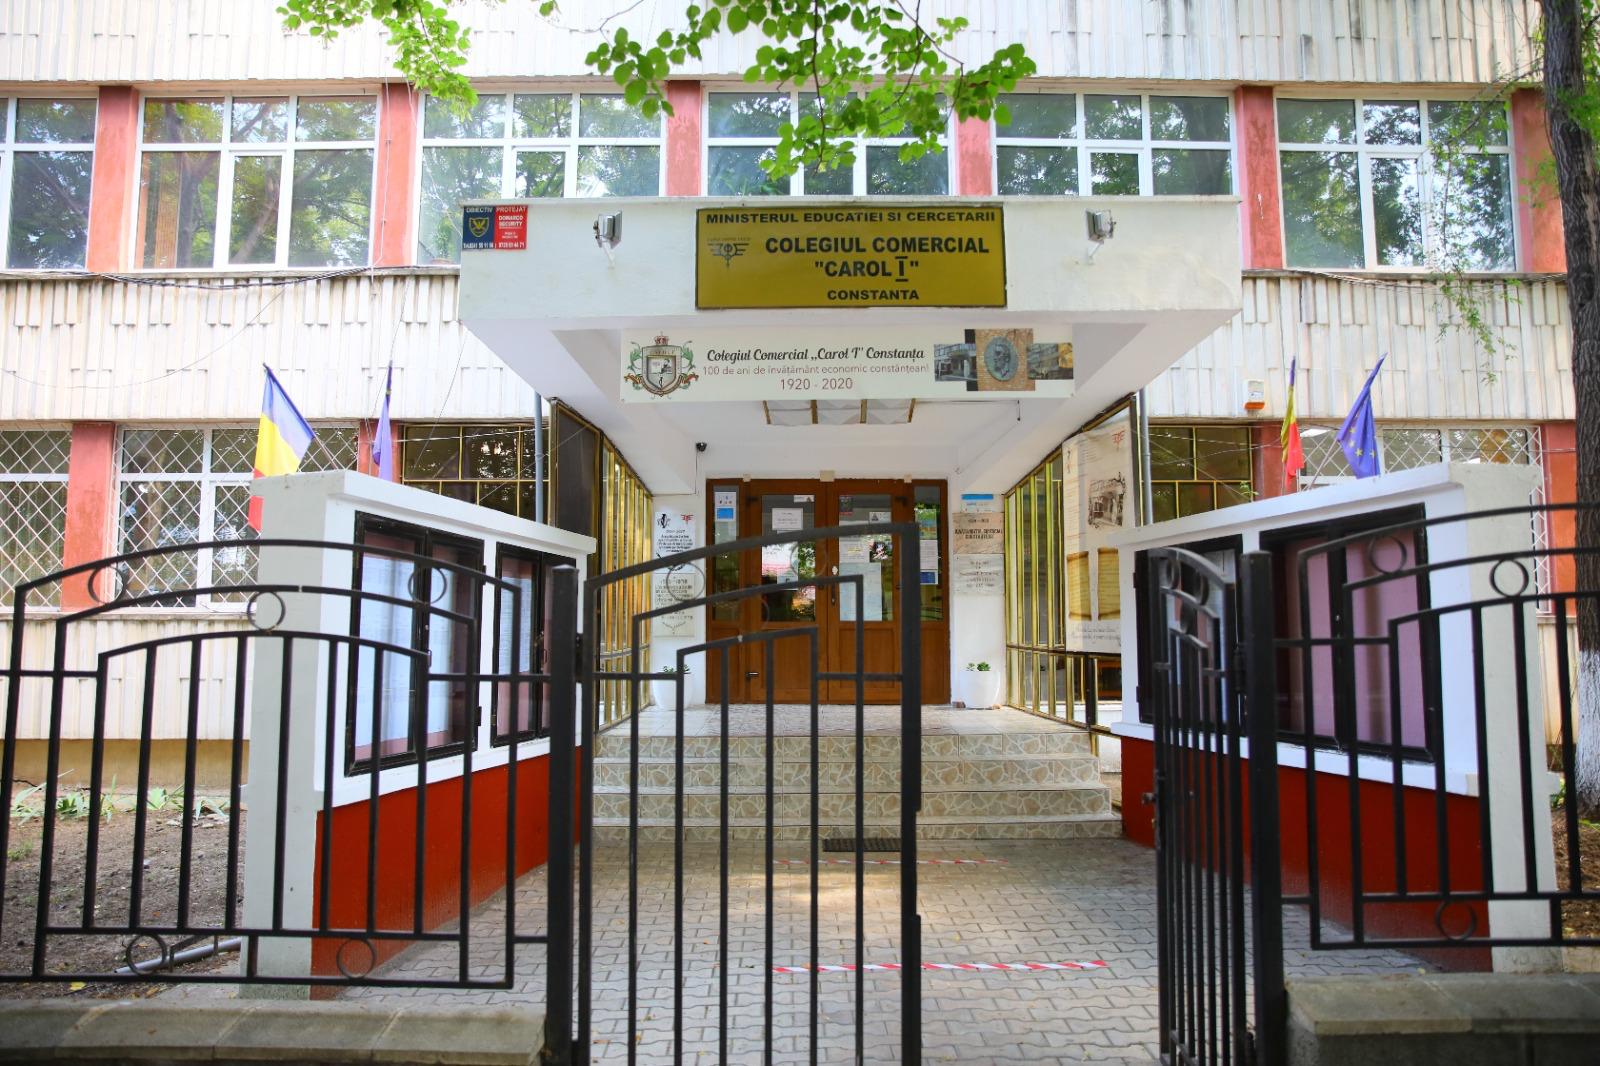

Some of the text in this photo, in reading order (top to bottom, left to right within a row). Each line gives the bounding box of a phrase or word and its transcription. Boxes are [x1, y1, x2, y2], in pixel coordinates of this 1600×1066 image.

[706, 211, 996, 223] MINISTERUL EDUCATIEI SI CERCETARII
[765, 236, 990, 254] COLEGIUL COMERCIAL
[815, 261, 893, 278] "CAROL
[827, 289, 920, 301] CONSTANTA
[707, 349, 751, 364] Colegiul
[753, 348, 808, 361] Comercial
[866, 346, 925, 362] Constanța
[703, 366, 720, 376] 100
[722, 366, 735, 375] de
[736, 366, 751, 375] ani
[753, 365, 766, 375] de
[821, 364, 868, 374] economic
[781, 378, 811, 390] 1920
[822, 377, 853, 390] 2020
